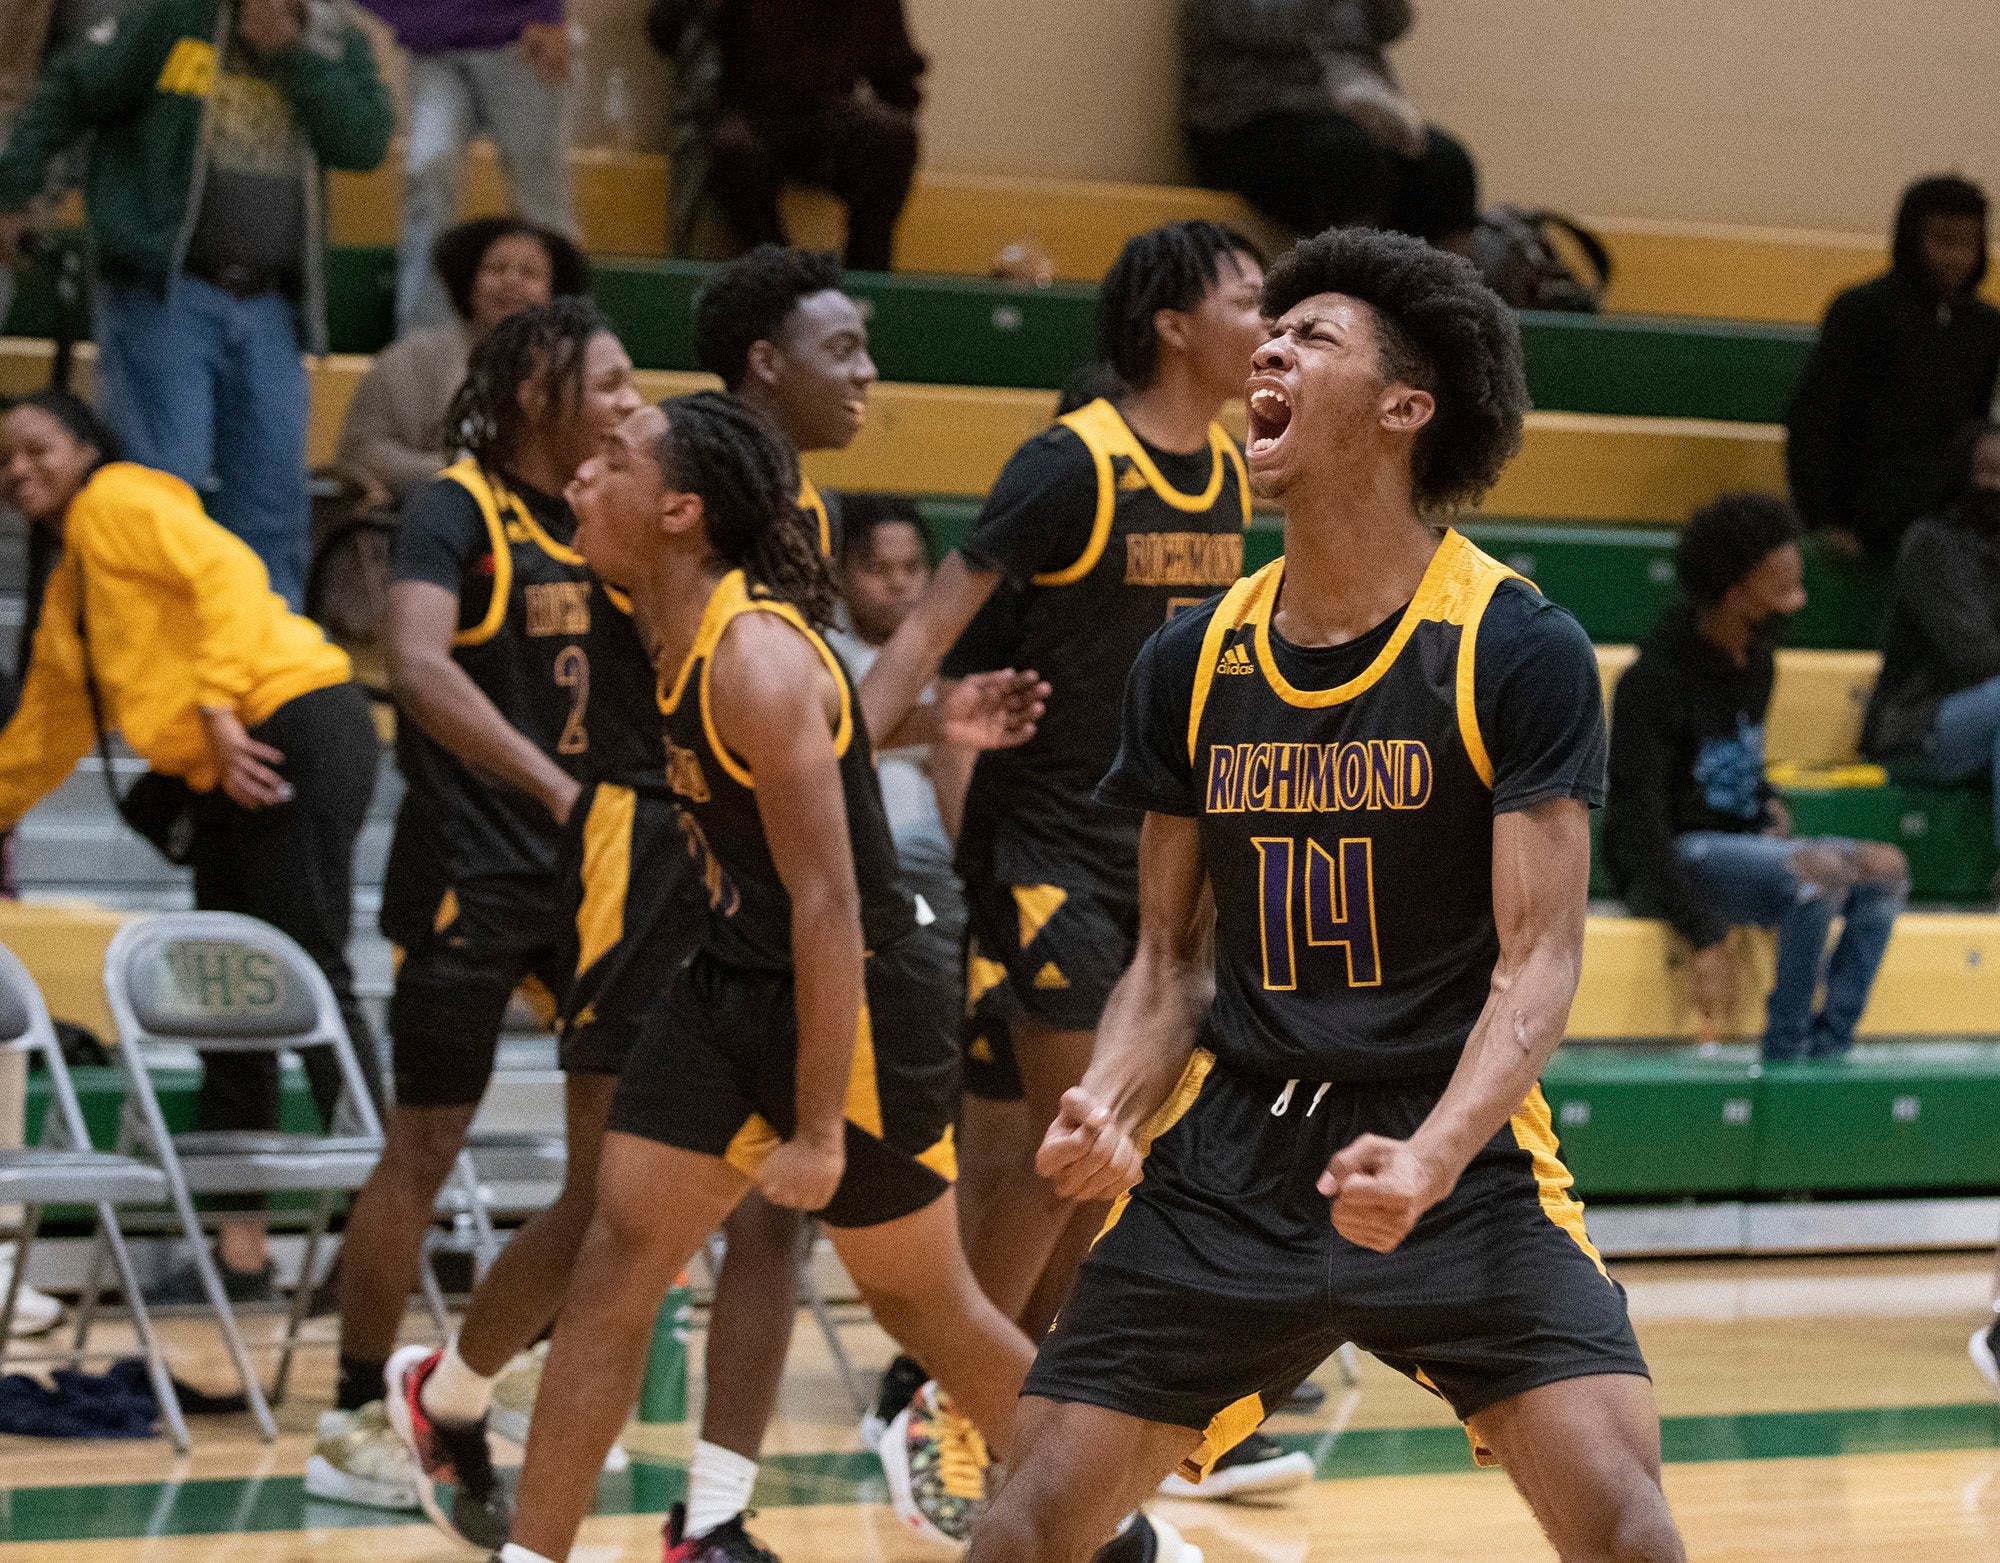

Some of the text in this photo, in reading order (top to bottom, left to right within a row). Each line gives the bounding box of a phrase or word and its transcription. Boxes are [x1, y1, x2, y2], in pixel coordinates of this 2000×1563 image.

[1216, 662, 1254, 675] adidas
[1206, 739, 1433, 813] RICHMOND
[1250, 837, 1382, 991] 14
